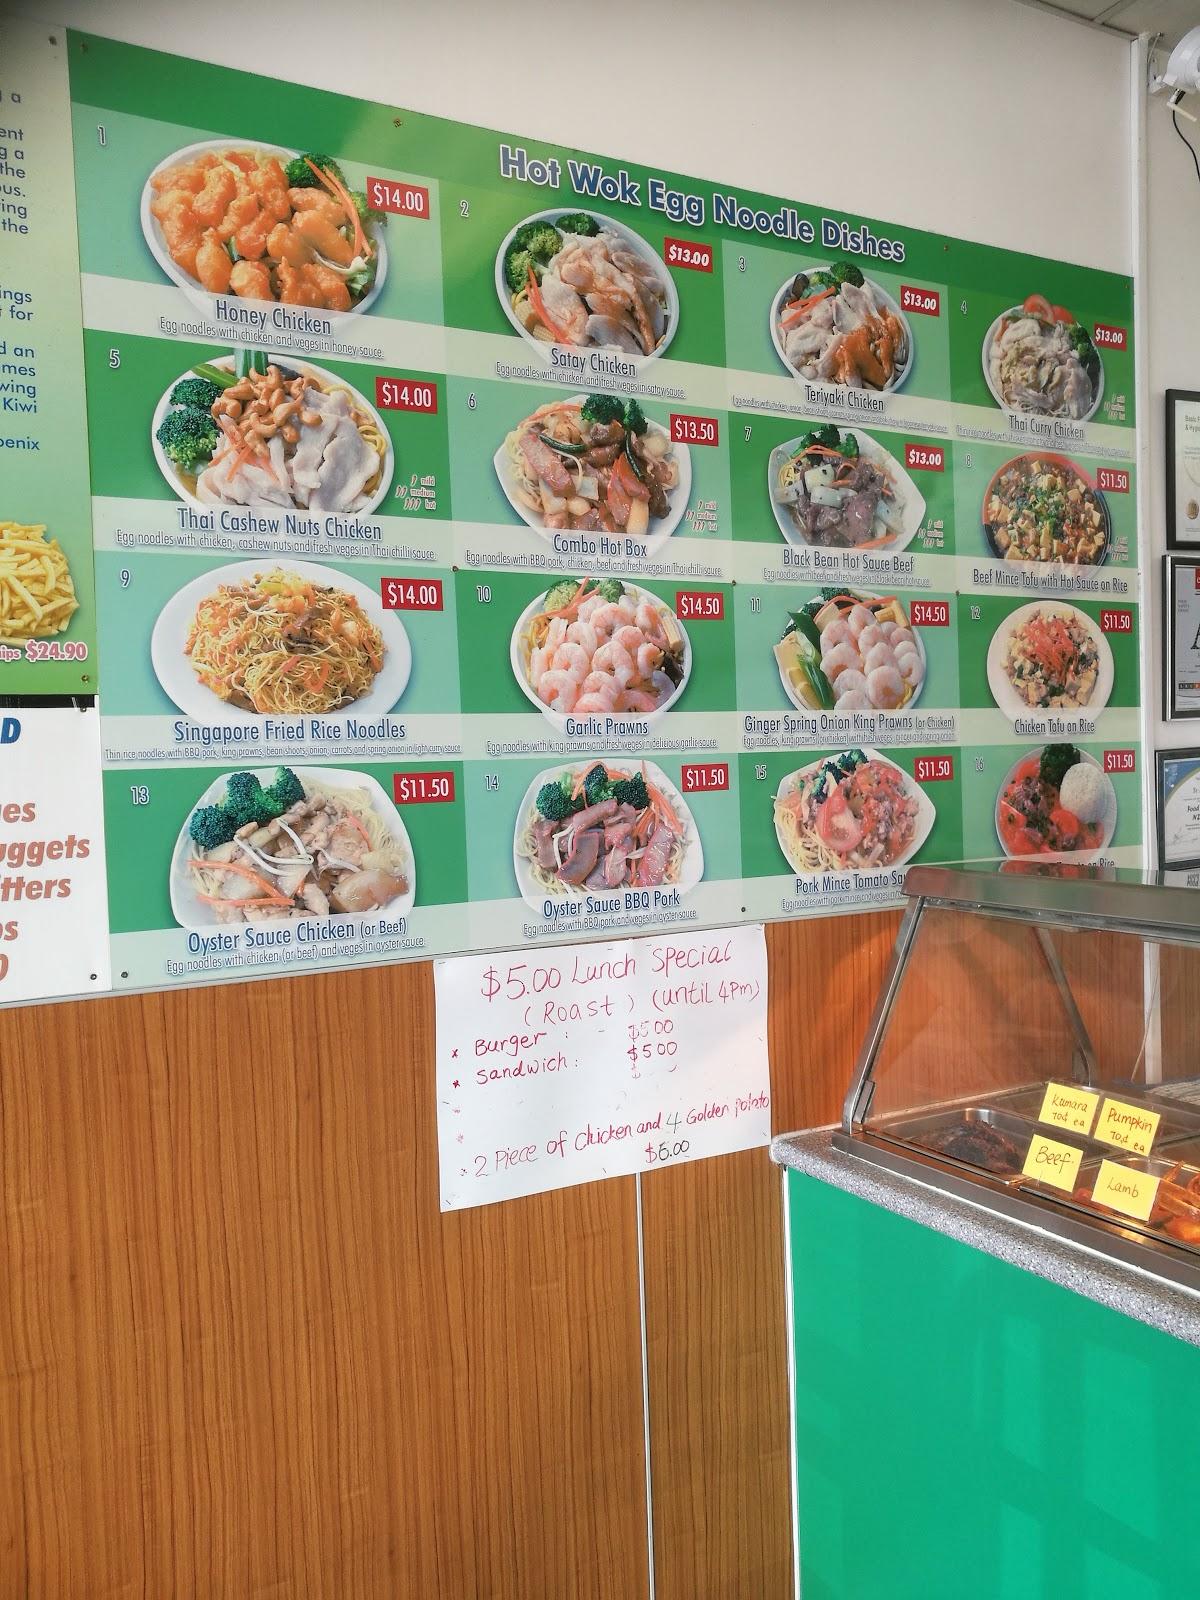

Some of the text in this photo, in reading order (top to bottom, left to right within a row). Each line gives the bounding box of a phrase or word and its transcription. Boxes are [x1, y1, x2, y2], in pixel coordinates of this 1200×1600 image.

[11, 92, 22, 103] a
[98, 125, 106, 146] 1
[14, 150, 24, 160] a
[374, 182, 424, 212] $14.00
[500, 144, 906, 263] Hot Wok Egg Noodle Dishes
[460, 199, 469, 218] 2
[2, 219, 28, 235] the
[669, 243, 710, 268] $13.00
[739, 256, 746, 272] 3
[903, 291, 937, 310] $13.00
[10, 305, 34, 321] for
[216, 299, 332, 335] Honey Chicken
[160, 317, 177, 334] Egg
[181, 321, 217, 338] noodles
[218, 325, 239, 340] with
[241, 327, 274, 346] chicken
[275, 331, 293, 347] and
[294, 336, 320, 352] veges
[321, 338, 330, 352] in
[332, 342, 358, 358] honey
[1094, 328, 1123, 345] $13.00
[14, 346, 35, 358] an
[110, 348, 120, 368] 5
[551, 348, 637, 378] Satay Chicken
[3, 397, 38, 414] Kiwi
[382, 382, 432, 408] $14.00
[468, 392, 477, 410] 6
[804, 384, 885, 411] Teriyaki Chicken
[675, 417, 714, 442] $13.50
[744, 426, 752, 442] 7
[1008, 414, 1028, 432] Thai
[1030, 418, 1052, 438] Curry
[1054, 421, 1085, 439] Chicken
[908, 448, 941, 466] $13.00
[1100, 470, 1127, 490] $11.50
[177, 508, 382, 541] Thai Cashew Nuts Chicken
[553, 534, 648, 557] Combo Hot Box
[783, 548, 914, 573] Black Bean Hot Sauce Beef
[121, 568, 130, 588] 9
[973, 568, 1128, 592] Beef Mince Tofu with Hot Sauce on Rice
[387, 582, 438, 606] $14.00
[477, 586, 491, 602] 10
[680, 594, 721, 616] $14.50
[750, 597, 760, 613] 11
[914, 603, 946, 622] $14.50
[1104, 613, 1130, 630] $11.50
[25, 640, 88, 662] $24.90
[174, 718, 406, 746] Singapore Fried Rice Noodles
[566, 717, 649, 736] Garlic Prawns
[744, 716, 781, 734] Ginger
[783, 714, 818, 733] Spring
[820, 714, 850, 730] Onion
[852, 714, 876, 732] King
[878, 713, 914, 730] Prawns
[927, 716, 955, 730] Chicken)
[1014, 718, 1096, 734] Chicken Tofu on Rice
[918, 759, 951, 778] $11.50
[1106, 752, 1133, 769] $11.50
[485, 774, 499, 790] 14
[686, 767, 725, 789] $11.50
[754, 765, 766, 780] 15
[130, 786, 150, 804] 13
[400, 777, 450, 801] $11.50
[796, 870, 906, 895] Pork Mince Tomato Sa
[544, 888, 681, 920] Oyster Sauce BBQ Pork
[188, 917, 408, 957] Oyster Sauce Chicken (or Beef)
[166, 958, 184, 976] Egg
[187, 954, 223, 972] noodles
[224, 951, 245, 967] with
[246, 948, 280, 965] chicken
[321, 944, 338, 958] and
[340, 940, 364, 957] veges
[376, 938, 400, 954] oyster
[480, 964, 562, 1002] $5.00
[571, 952, 637, 985] Lunch
[652, 981, 714, 1013] (until
[475, 1032, 547, 1057] Burger
[1052, 1094, 1088, 1112] Kumara
[1108, 1107, 1152, 1134] Pumpkin
[474, 1155, 489, 1178] 2
[496, 1144, 538, 1172] Piece
[546, 1130, 568, 1159] of
[636, 1112, 662, 1135] and
[666, 1111, 682, 1135] 4
[686, 1102, 729, 1126] Golden
[1106, 1177, 1139, 1198] Lamb
